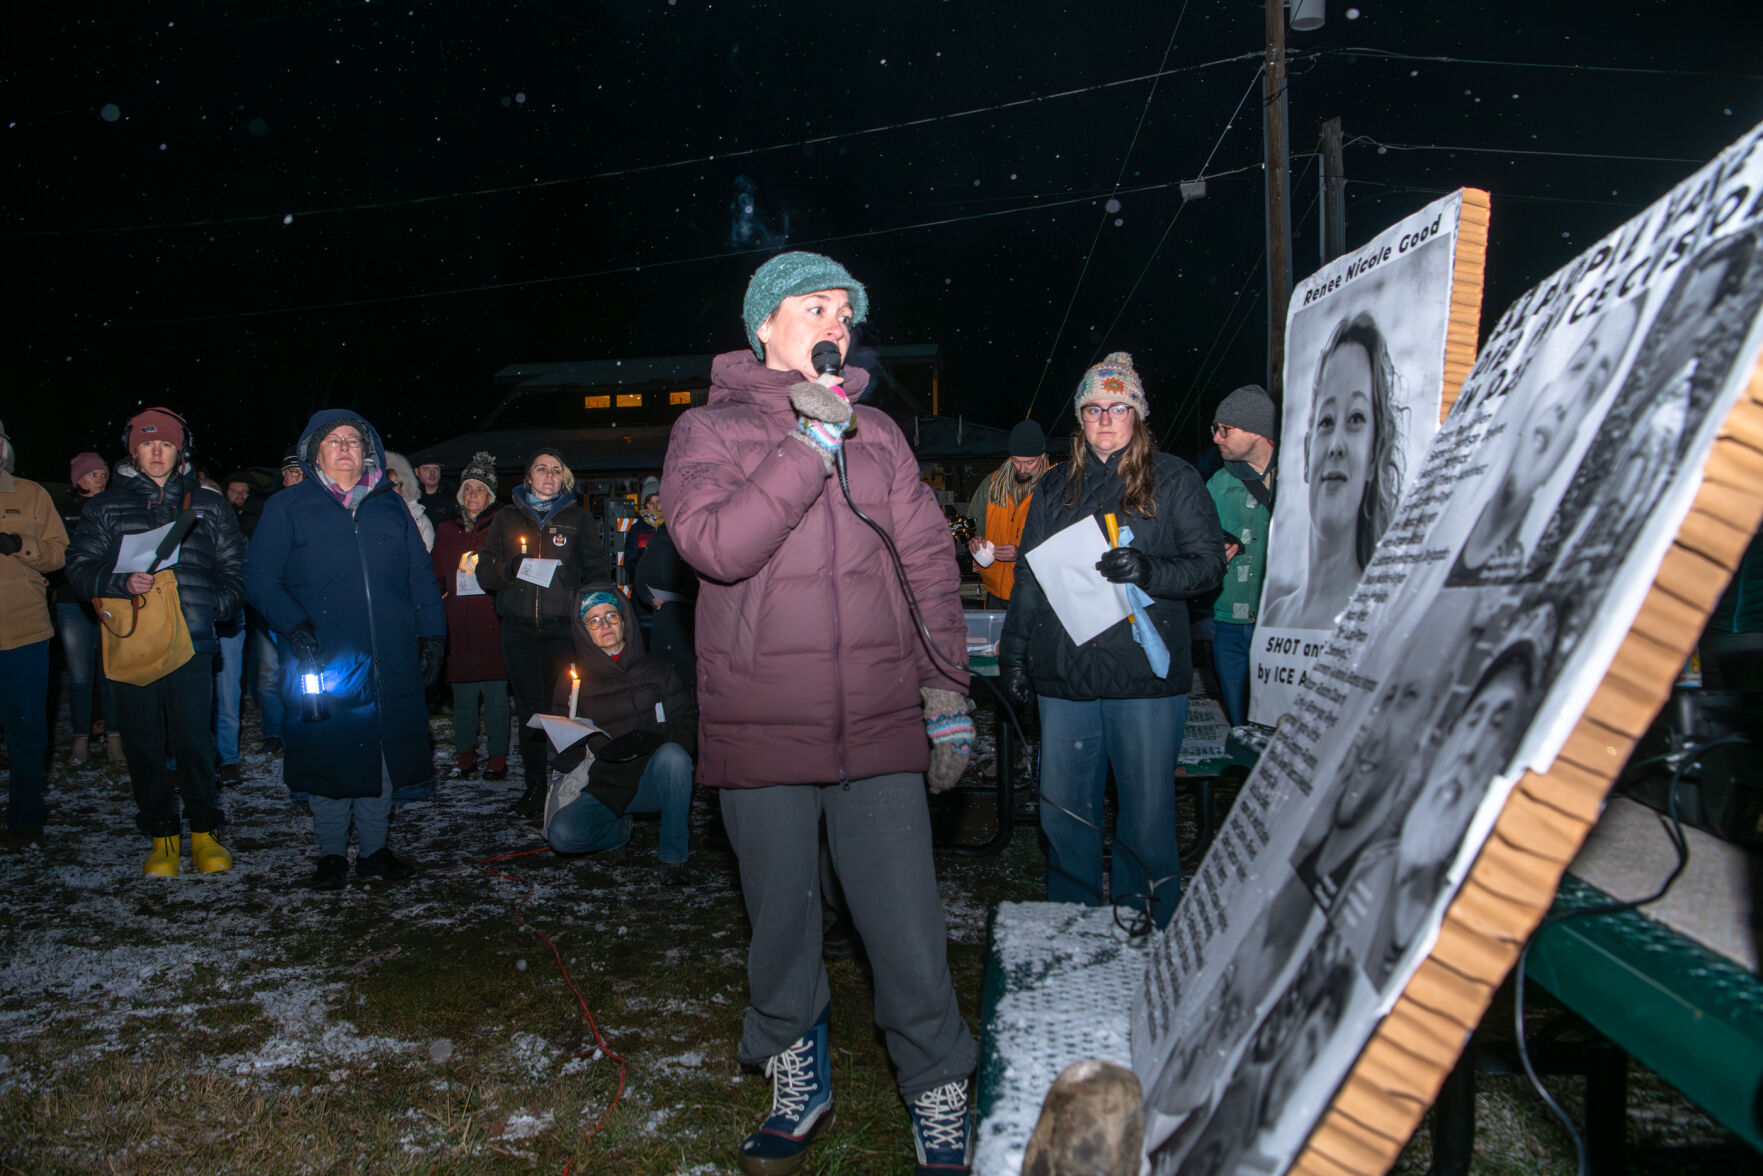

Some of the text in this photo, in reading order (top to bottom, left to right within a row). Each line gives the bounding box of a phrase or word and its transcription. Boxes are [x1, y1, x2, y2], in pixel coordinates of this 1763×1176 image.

[1303, 213, 1442, 306] Renee Nicole Good
[1265, 636, 1301, 656] SHOT
[1257, 663, 1271, 684] by
[1274, 666, 1296, 685] ICE
